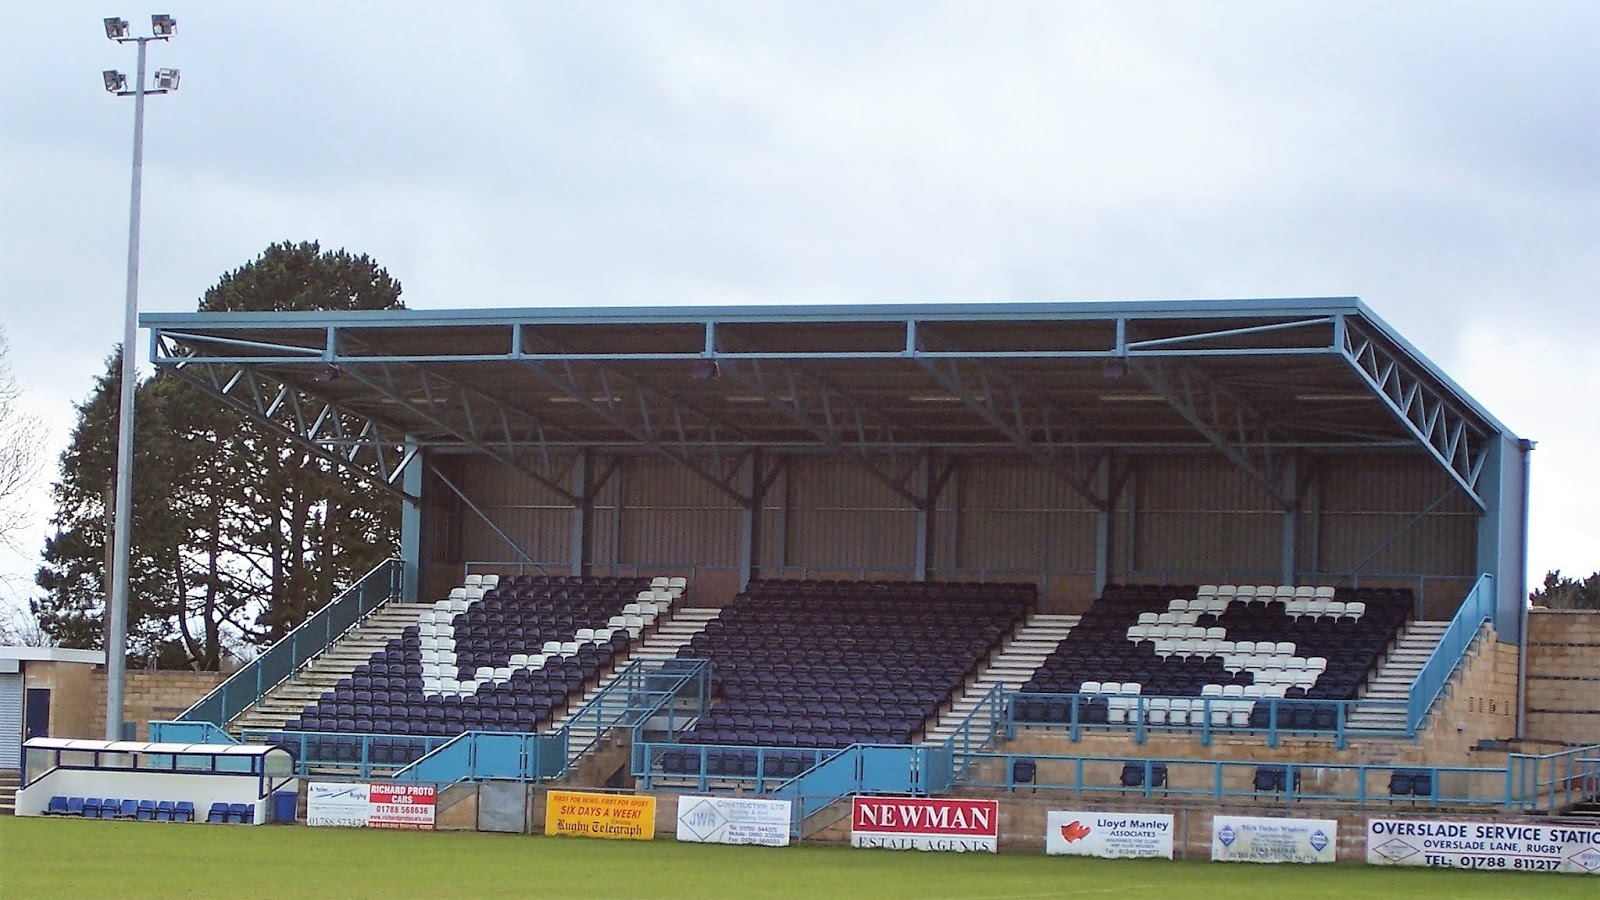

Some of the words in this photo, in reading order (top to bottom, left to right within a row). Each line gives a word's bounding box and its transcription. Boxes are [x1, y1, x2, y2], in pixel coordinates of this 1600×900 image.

[349, 792, 367, 800] Rugby
[370, 785, 407, 795] RICHARD
[408, 787, 434, 796] PROTO
[391, 796, 414, 804] CARS
[553, 795, 569, 803] FIRST
[601, 798, 617, 806] FIRST
[617, 799, 629, 807] FOR
[630, 800, 649, 808] SPORT
[716, 800, 768, 810] CONSTRUCTION
[771, 803, 785, 811] LTD
[560, 805, 578, 816] SIX
[578, 806, 602, 818] DAYS
[603, 808, 610, 818] A
[613, 809, 642, 820] WEEK!
[858, 803, 992, 829] NEWMAN
[309, 817, 335, 826] 01788
[689, 812, 717, 827] JWR
[1097, 819, 1127, 830] Lloyd
[1130, 820, 1169, 832] Manley
[557, 818, 589, 833] Rugby
[592, 821, 642, 838] Telegraph
[1109, 830, 1156, 838] ASSOCIATES
[1372, 822, 1468, 838] OVERSLADE
[1476, 826, 1541, 841] SERVICE
[858, 836, 919, 849] ESTATE
[927, 839, 990, 852] AGENTS
[1423, 840, 1485, 850] OVERSLADE
[1490, 842, 1521, 853] LANE,
[1527, 844, 1563, 854] RUGBY
[1424, 855, 1452, 866] TEL:
[1460, 856, 1505, 867] 01788
[1513, 858, 1562, 870] 811217
